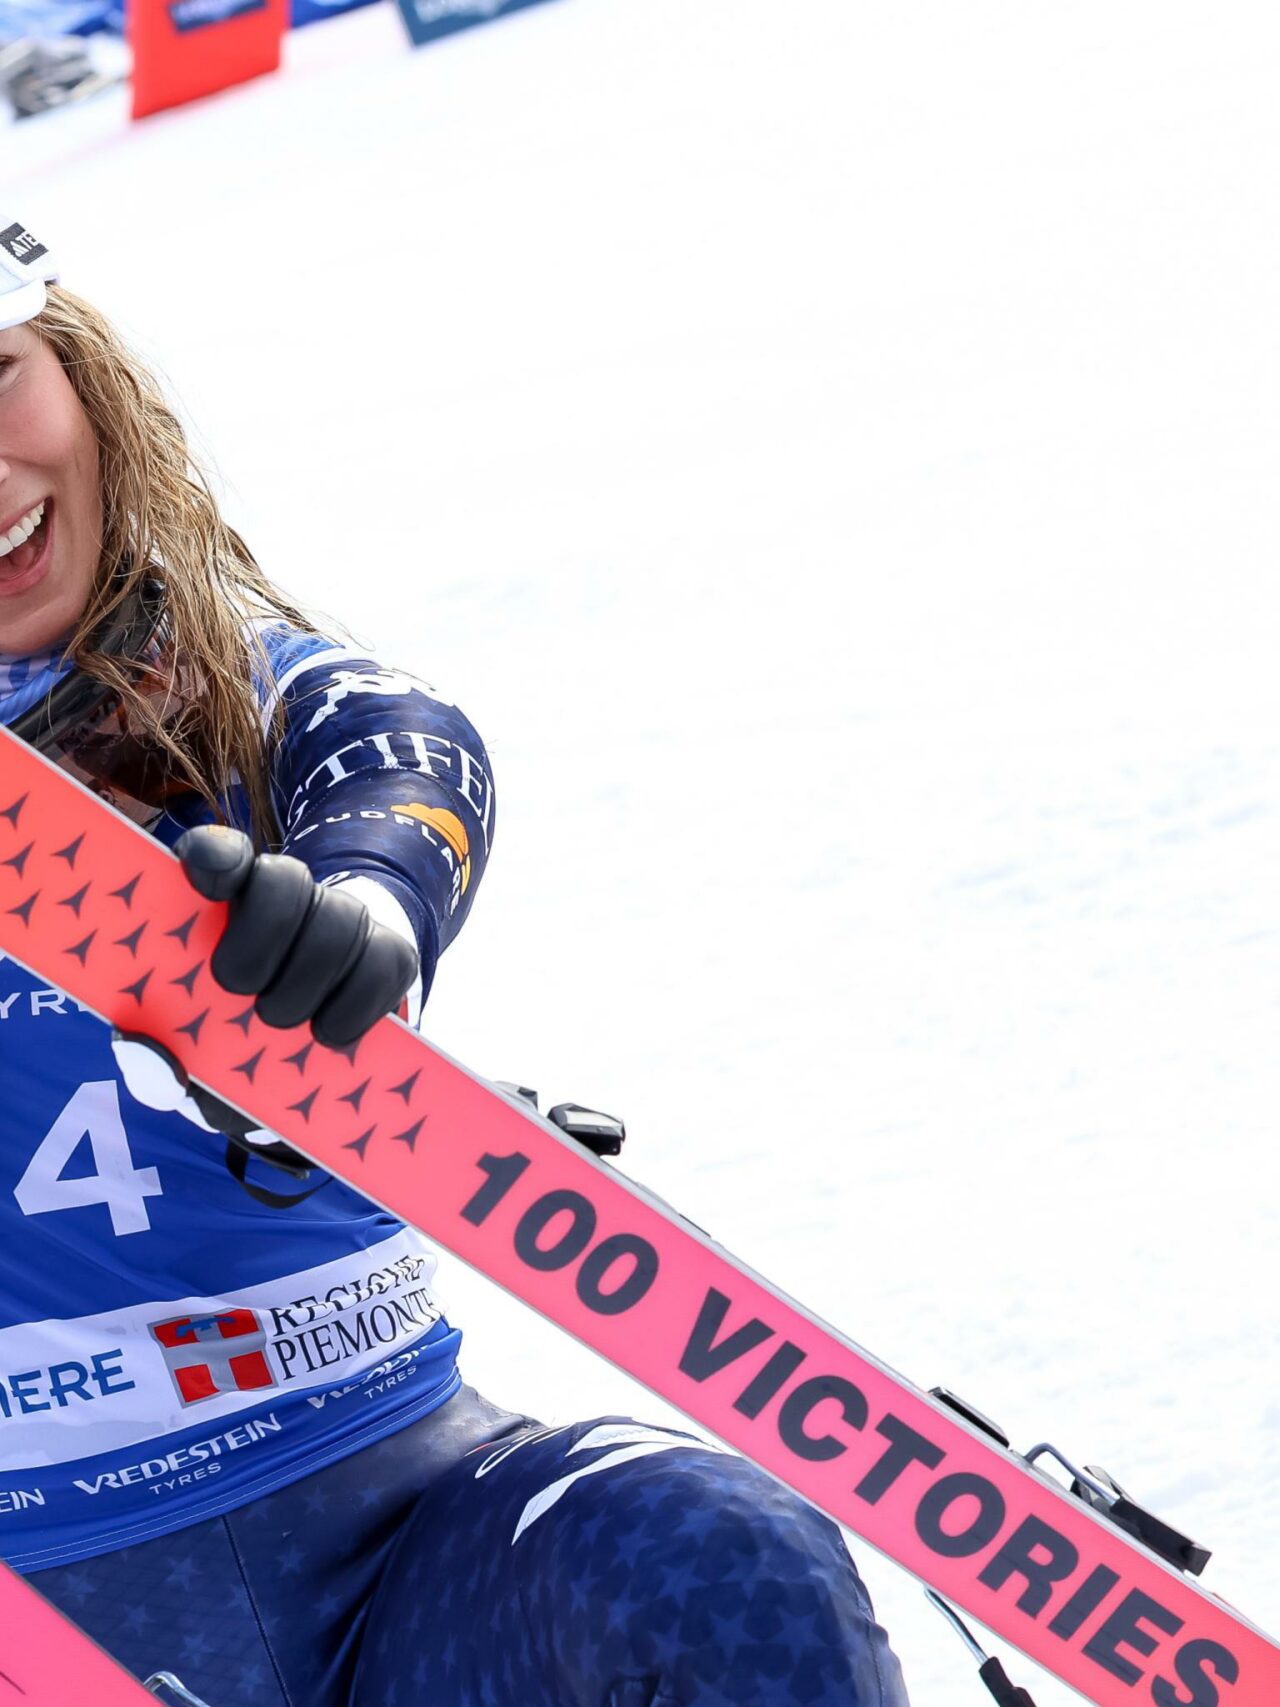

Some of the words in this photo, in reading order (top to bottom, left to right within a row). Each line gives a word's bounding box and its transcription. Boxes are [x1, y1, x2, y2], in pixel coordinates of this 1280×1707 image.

[14, 1080, 163, 1236] 4
[364, 1365, 417, 1399] TYRES
[73, 1413, 282, 1496] VREDESTEIN
[458, 1151, 659, 1316] 100
[677, 1286, 1240, 1707] VICTORIES
[149, 1463, 222, 1496] TYRES
